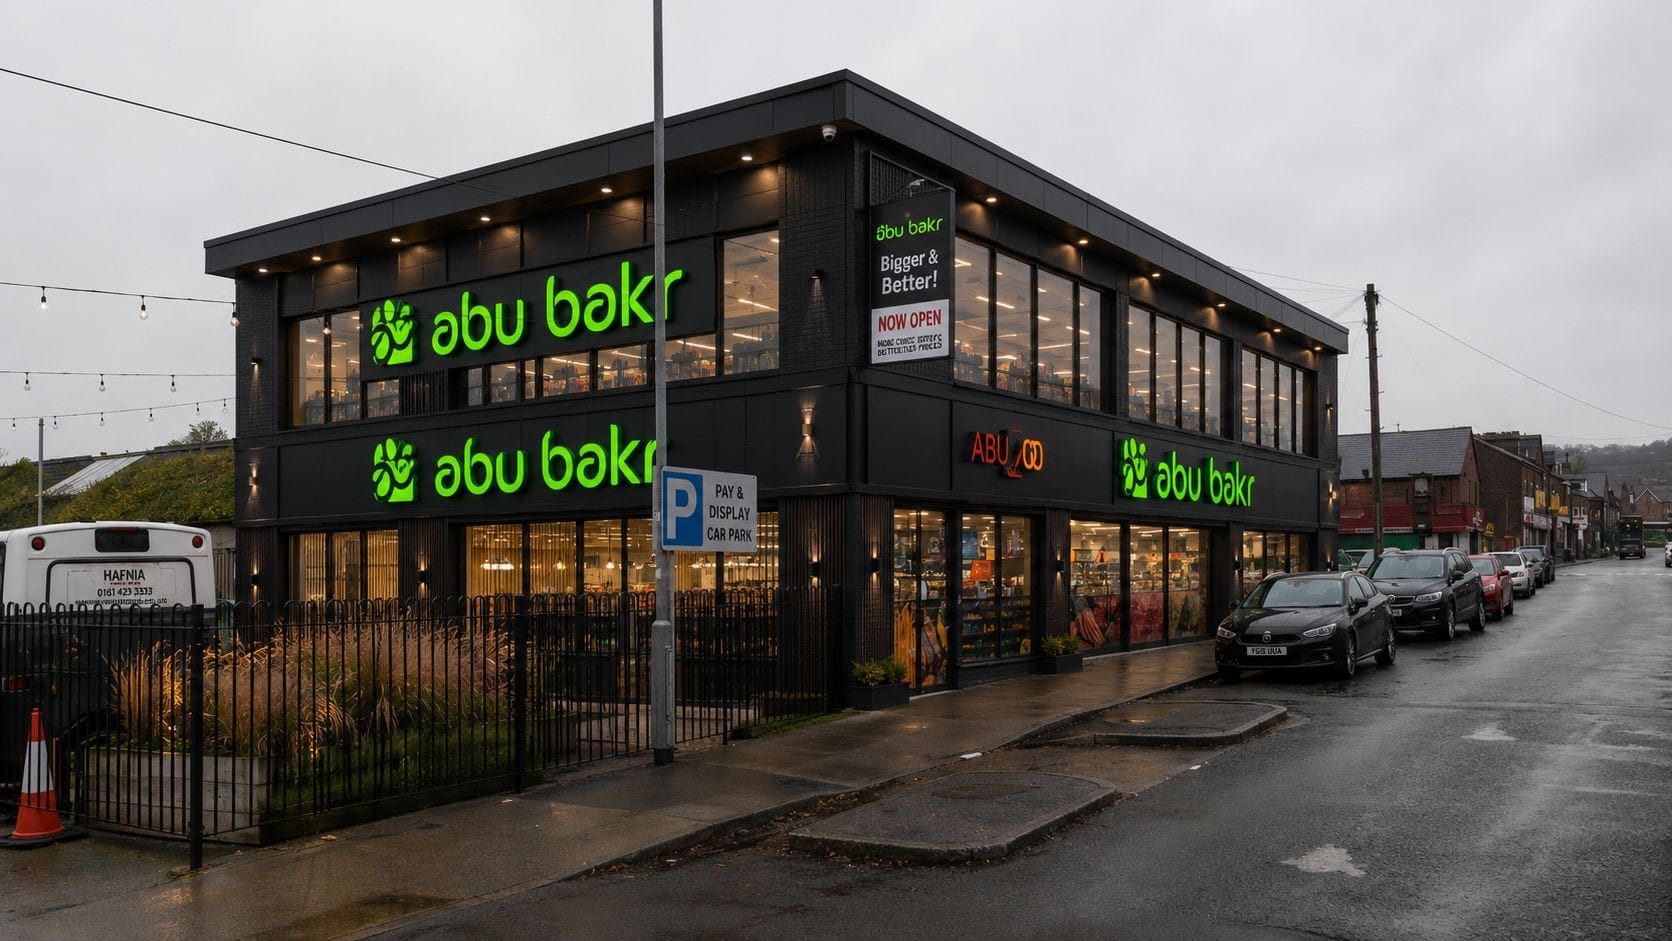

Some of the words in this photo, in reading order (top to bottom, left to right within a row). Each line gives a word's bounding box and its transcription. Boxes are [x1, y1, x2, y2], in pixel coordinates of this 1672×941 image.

[908, 216, 943, 235] bakr
[880, 252, 926, 274] Bigger
[928, 248, 939, 265] &
[881, 270, 938, 295] Better!
[431, 291, 525, 356] abu
[546, 261, 684, 338] bakr
[878, 313, 908, 333] NOW
[910, 308, 942, 331] OPEN
[971, 431, 1009, 465] ABU
[434, 437, 525, 497] abu
[1156, 450, 1202, 502] abu
[1209, 457, 1256, 507] bakr
[715, 484, 734, 500] PAY
[736, 486, 744, 500] &
[667, 477, 697, 539] P
[709, 505, 751, 520] DISPLAY
[707, 527, 726, 541] CAR
[728, 528, 752, 542] PARK
[103, 569, 146, 581] HAFNIA
[97, 588, 115, 597] 0161
[117, 587, 132, 596] 423
